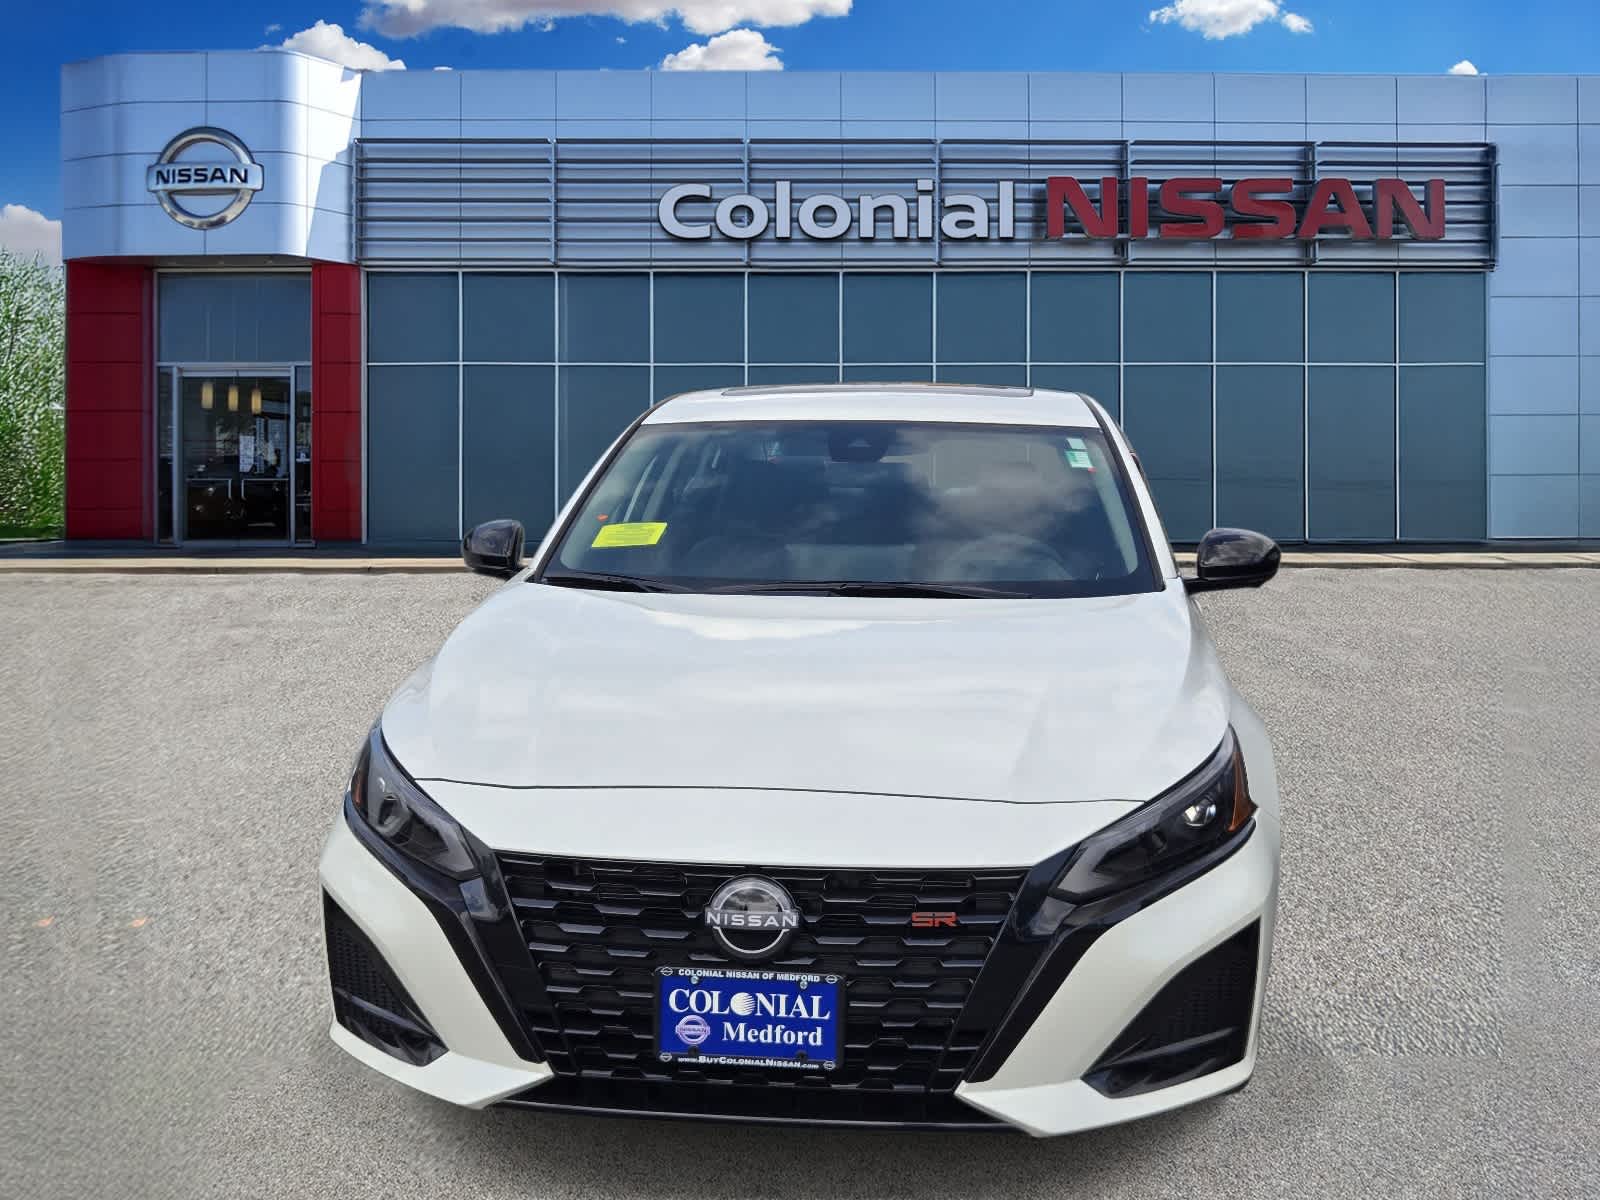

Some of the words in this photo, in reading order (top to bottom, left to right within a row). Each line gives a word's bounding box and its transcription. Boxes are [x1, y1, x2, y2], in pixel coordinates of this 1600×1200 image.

[156, 168, 248, 185] NISSAN
[658, 178, 1015, 240] Colonial
[1046, 176, 1446, 240] NISSAN
[706, 911, 798, 927] NISSAN
[911, 912, 957, 927] SR
[678, 968, 724, 978] COLONIAL
[726, 971, 760, 980] NISSAN
[762, 972, 775, 981] OF
[777, 973, 820, 983] MEDFORD
[722, 1022, 823, 1046] Medford
